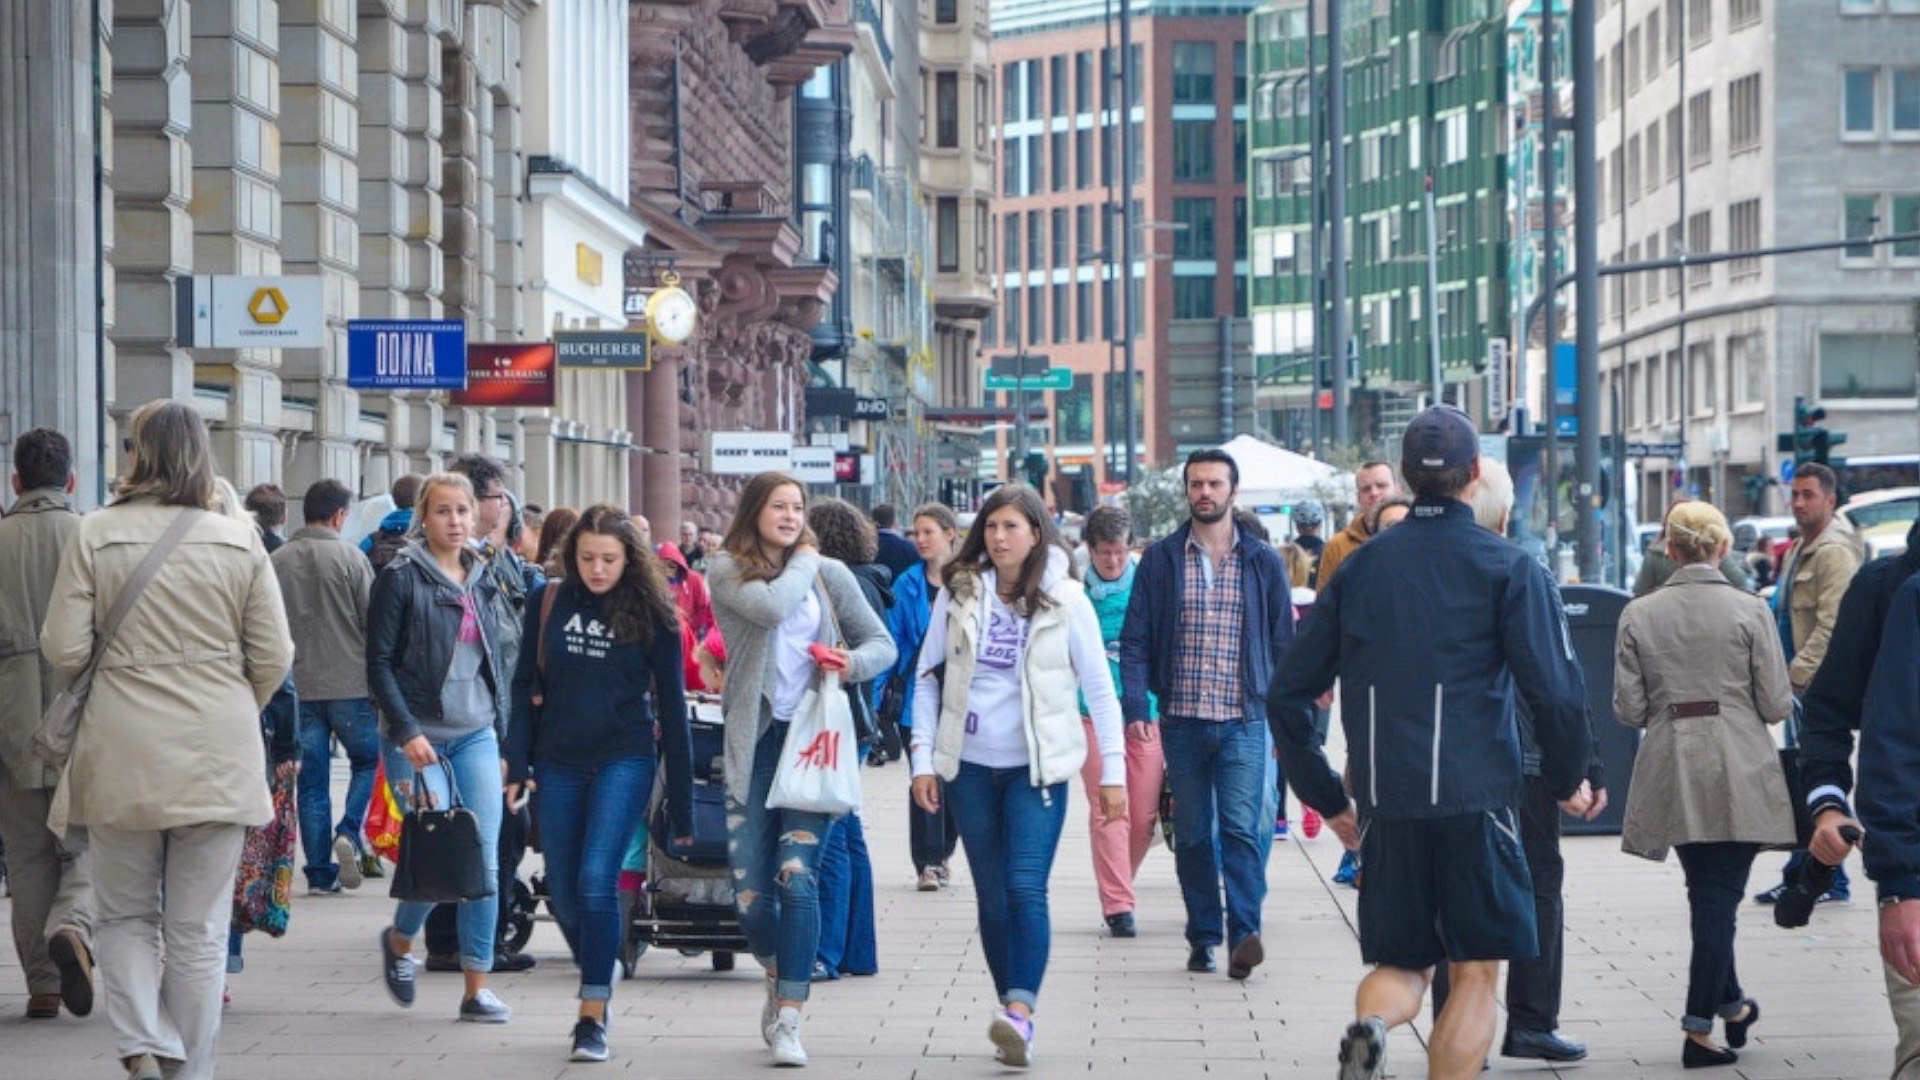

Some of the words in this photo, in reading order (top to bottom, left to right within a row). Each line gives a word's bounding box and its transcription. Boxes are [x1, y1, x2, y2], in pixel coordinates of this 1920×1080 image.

[375, 332, 435, 376] DONNA
[559, 342, 641, 355] BUCHERER
[715, 448, 748, 456] GERRY
[753, 448, 788, 456] WEBER
